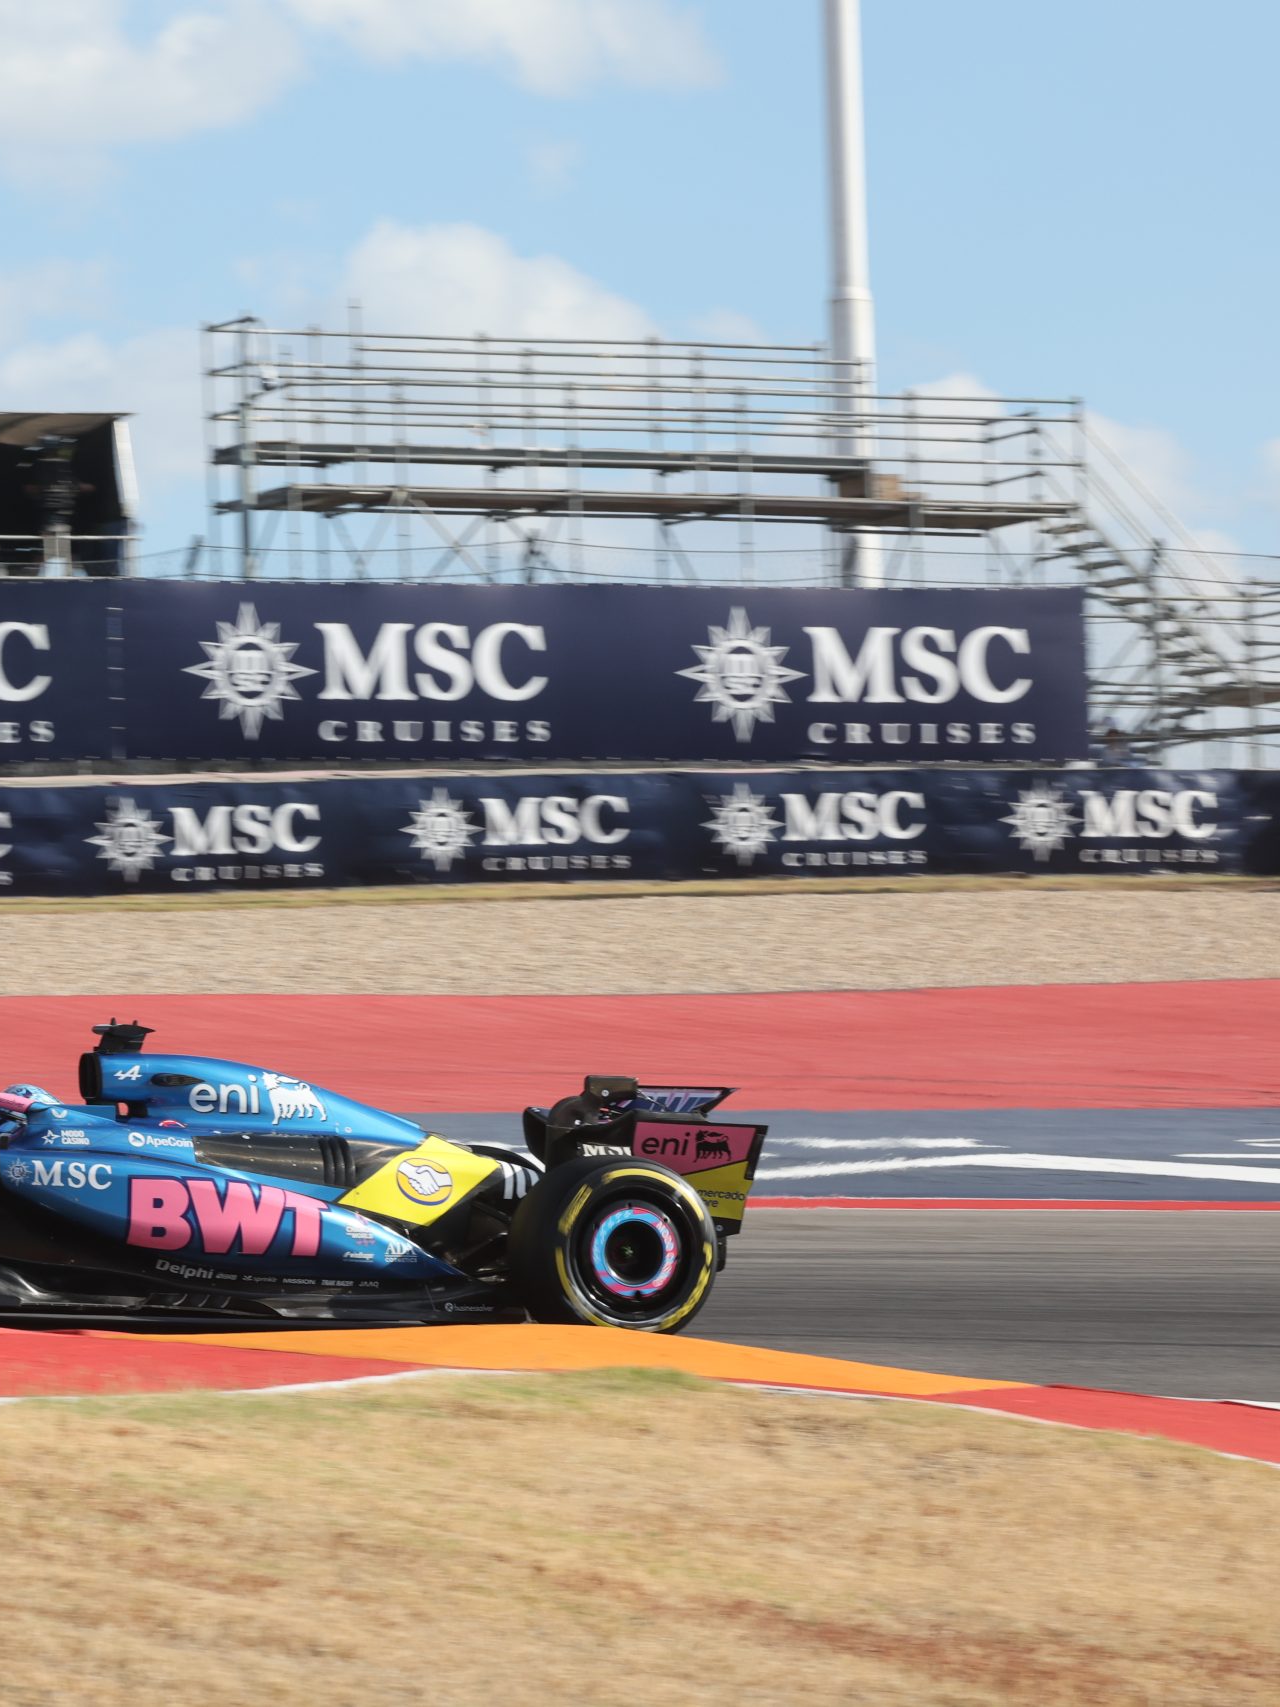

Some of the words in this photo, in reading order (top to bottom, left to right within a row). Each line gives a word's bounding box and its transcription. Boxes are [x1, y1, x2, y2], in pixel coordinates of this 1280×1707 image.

[314, 623, 548, 702] MSC
[802, 626, 1032, 704] MSC
[318, 720, 551, 743] CRUISES
[808, 722, 1036, 745] CRUISES
[170, 803, 321, 856] MSC
[480, 796, 630, 846] MSC
[782, 792, 925, 842] MSC
[1082, 790, 1219, 839] MSC
[188, 1074, 260, 1115] eni
[146, 1135, 194, 1149] ApeCoin
[641, 1132, 691, 1156] eni
[31, 1159, 113, 1190] MSC
[697, 1189, 745, 1201] mercado
[126, 1175, 329, 1258] BWT
[155, 1259, 215, 1279] Delphi
